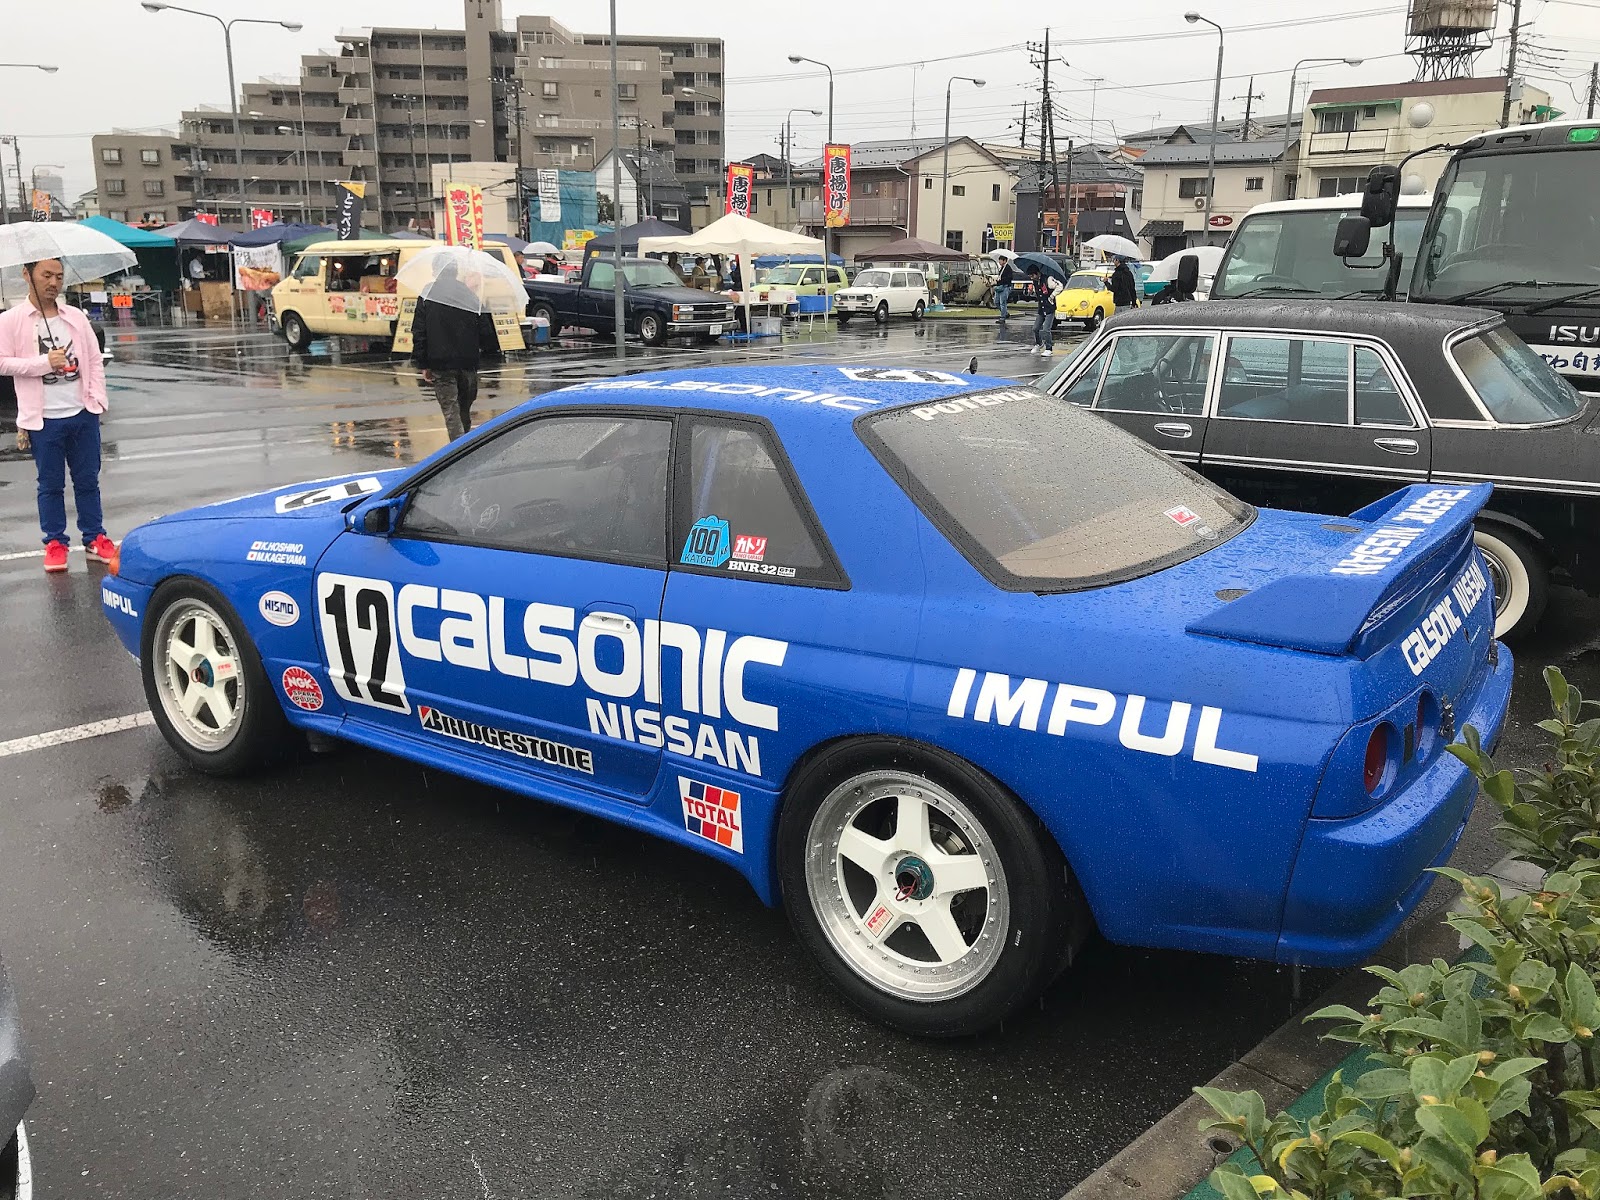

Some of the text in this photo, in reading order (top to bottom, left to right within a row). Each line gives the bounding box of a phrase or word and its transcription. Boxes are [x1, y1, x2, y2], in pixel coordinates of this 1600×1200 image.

[829, 156, 848, 210] 唐揚げ
[1548, 325, 1600, 343] ISU
[910, 389, 1042, 421] POTENZA
[260, 542, 304, 554] K.HOSHINO
[688, 528, 721, 554] 100
[735, 537, 766, 555] カトリ
[256, 552, 307, 566] M.KAGEYAMA
[684, 554, 715, 565] KATORI
[727, 560, 777, 576] BNR32
[102, 587, 138, 618] IMPUL
[1452, 560, 1487, 618] NISSAN
[264, 599, 294, 614] NISMO
[325, 583, 405, 709] 12
[287, 676, 315, 690] NGK
[947, 667, 1259, 773] IMPUL
[419, 706, 594, 774] BRIDGESTONE
[586, 698, 762, 777] NISSAN
[683, 796, 740, 831] TOTAL
